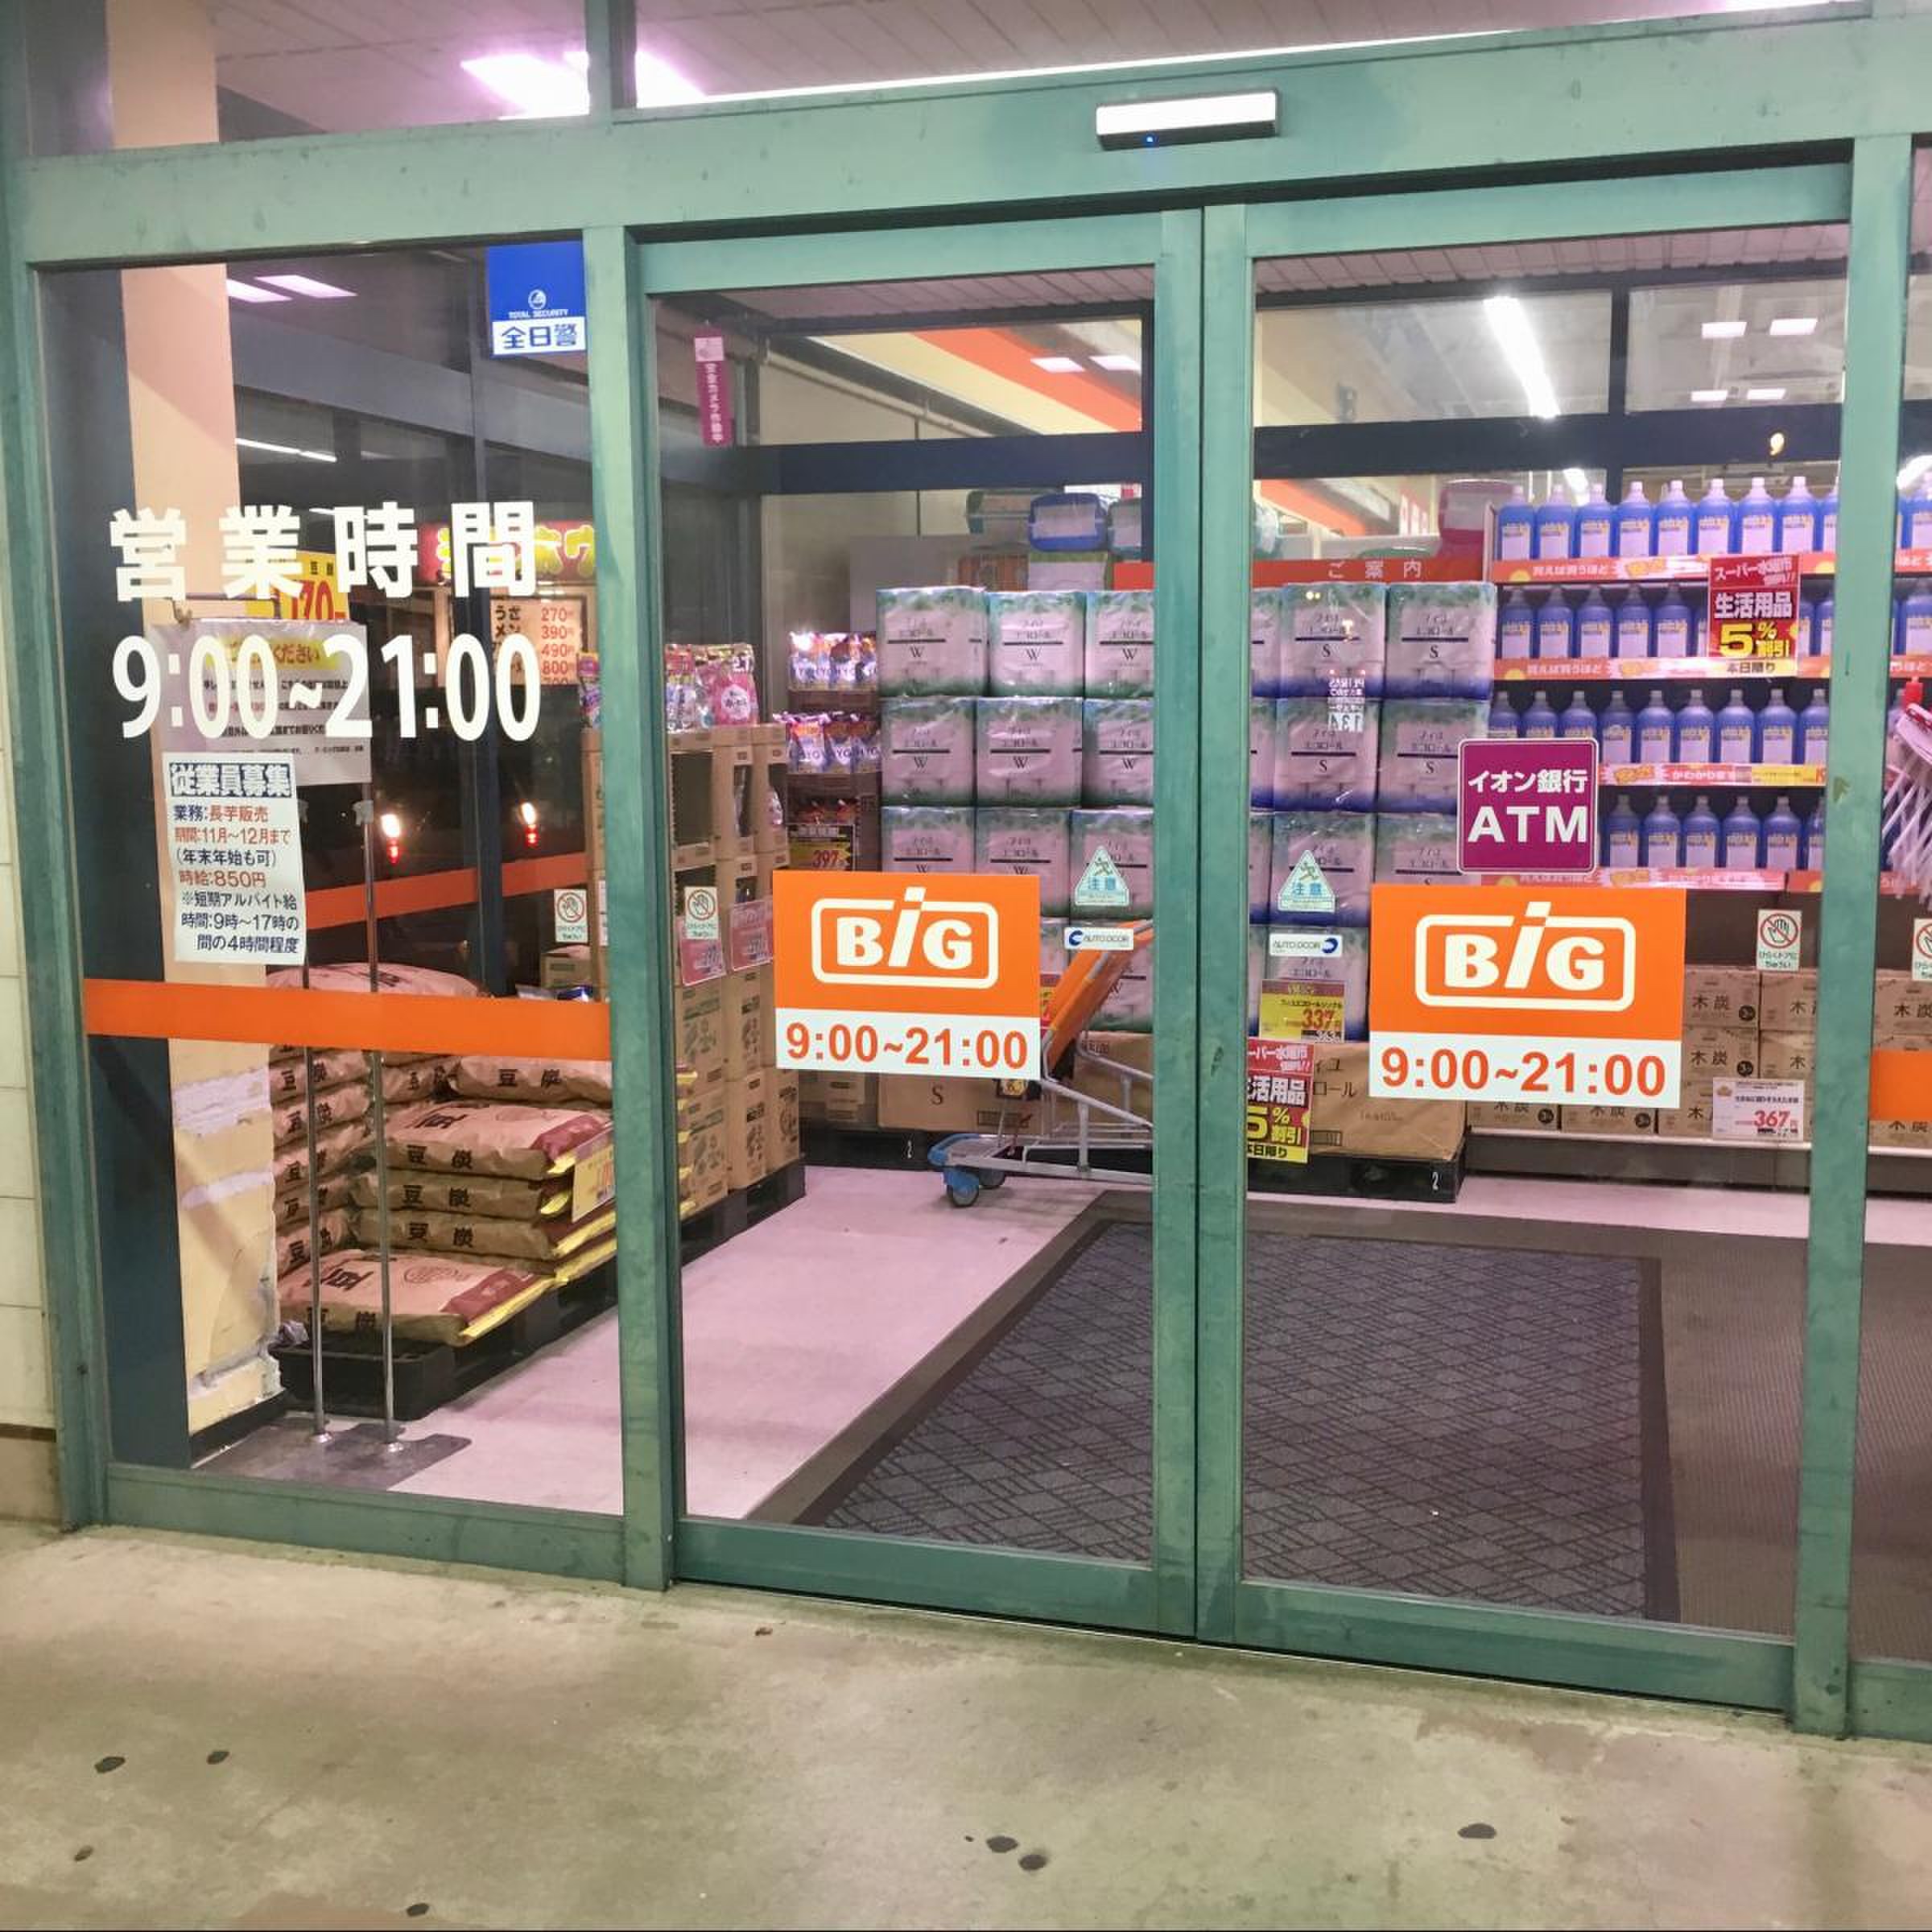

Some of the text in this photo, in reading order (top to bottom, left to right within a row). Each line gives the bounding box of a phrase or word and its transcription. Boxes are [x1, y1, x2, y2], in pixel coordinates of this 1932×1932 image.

[109, 502, 535, 602] 営業時間
[1715, 592, 1794, 619] 生活用品
[170, 763, 292, 798] 従業員募集
[1468, 770, 1588, 794] イオン銀行
[1468, 806, 1587, 843] ATM
[180, 870, 266, 888] 時給:850円
[197, 935, 299, 953] 間の4時間程度
[1302, 1009, 1335, 1030] 337
[498, 1068, 562, 1088] 豆炭
[931, 1085, 944, 1105] S
[1248, 1075, 1307, 1106] 活用品
[1754, 1110, 1791, 1128] 367
[407, 1144, 473, 1169] 豆炭
[403, 1184, 470, 1208] 豆炭
[409, 1222, 474, 1248] 豆炭
